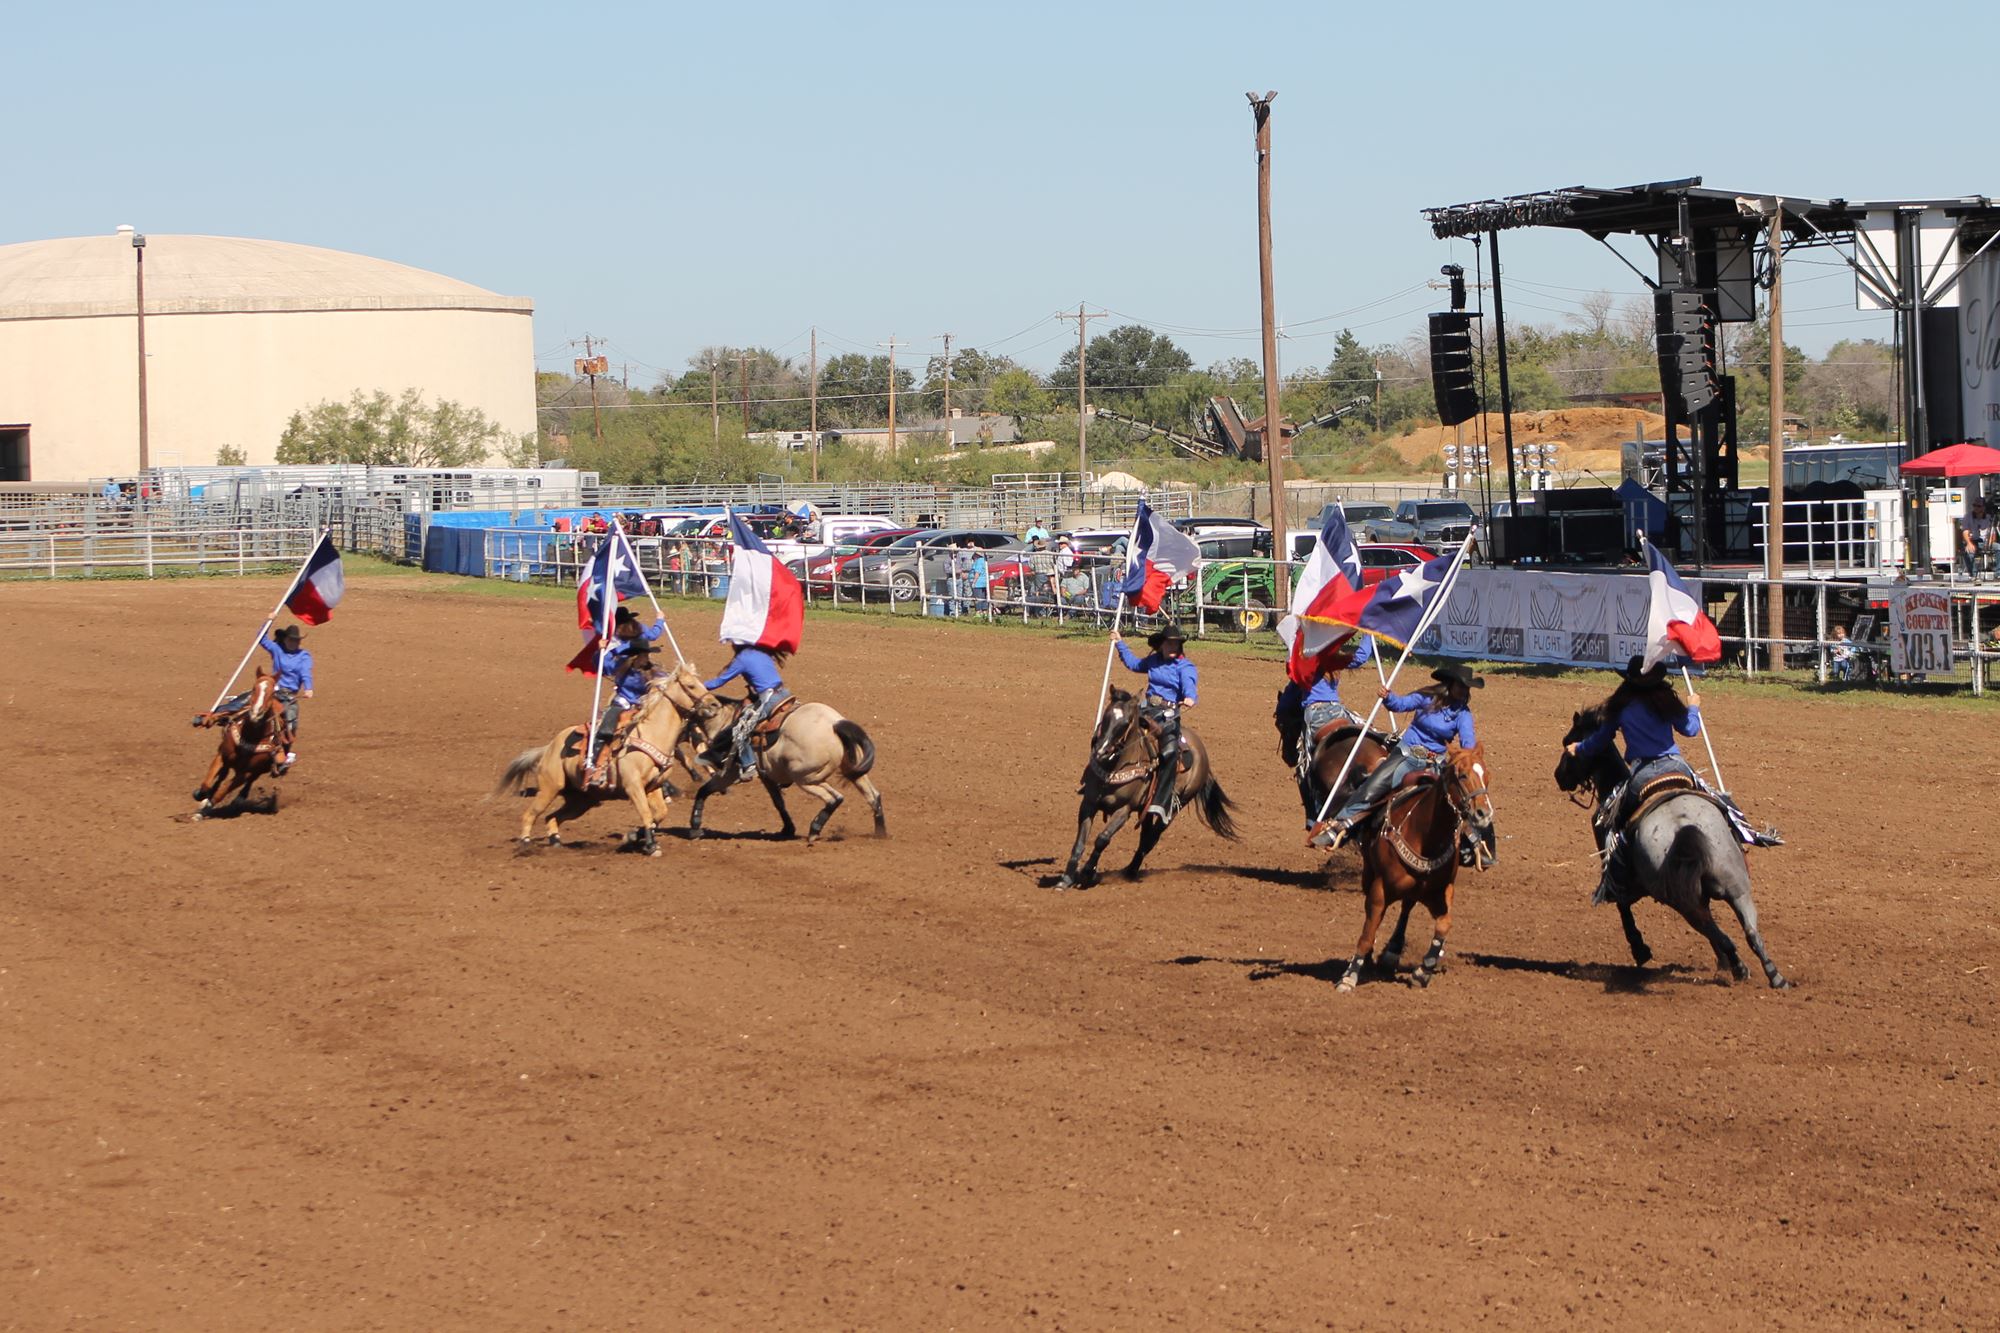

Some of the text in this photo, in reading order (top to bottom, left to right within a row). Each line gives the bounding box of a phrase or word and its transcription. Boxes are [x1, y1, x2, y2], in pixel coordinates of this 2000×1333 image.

[1906, 614, 1949, 630] COUNTRY
[1450, 630, 1478, 646] FLIGHT
[1490, 633, 1519, 650] FLIGHT
[1533, 634, 1561, 651] FLIGHT
[1575, 639, 1605, 656] FLIGHT
[1901, 633, 1951, 671] 103.1
